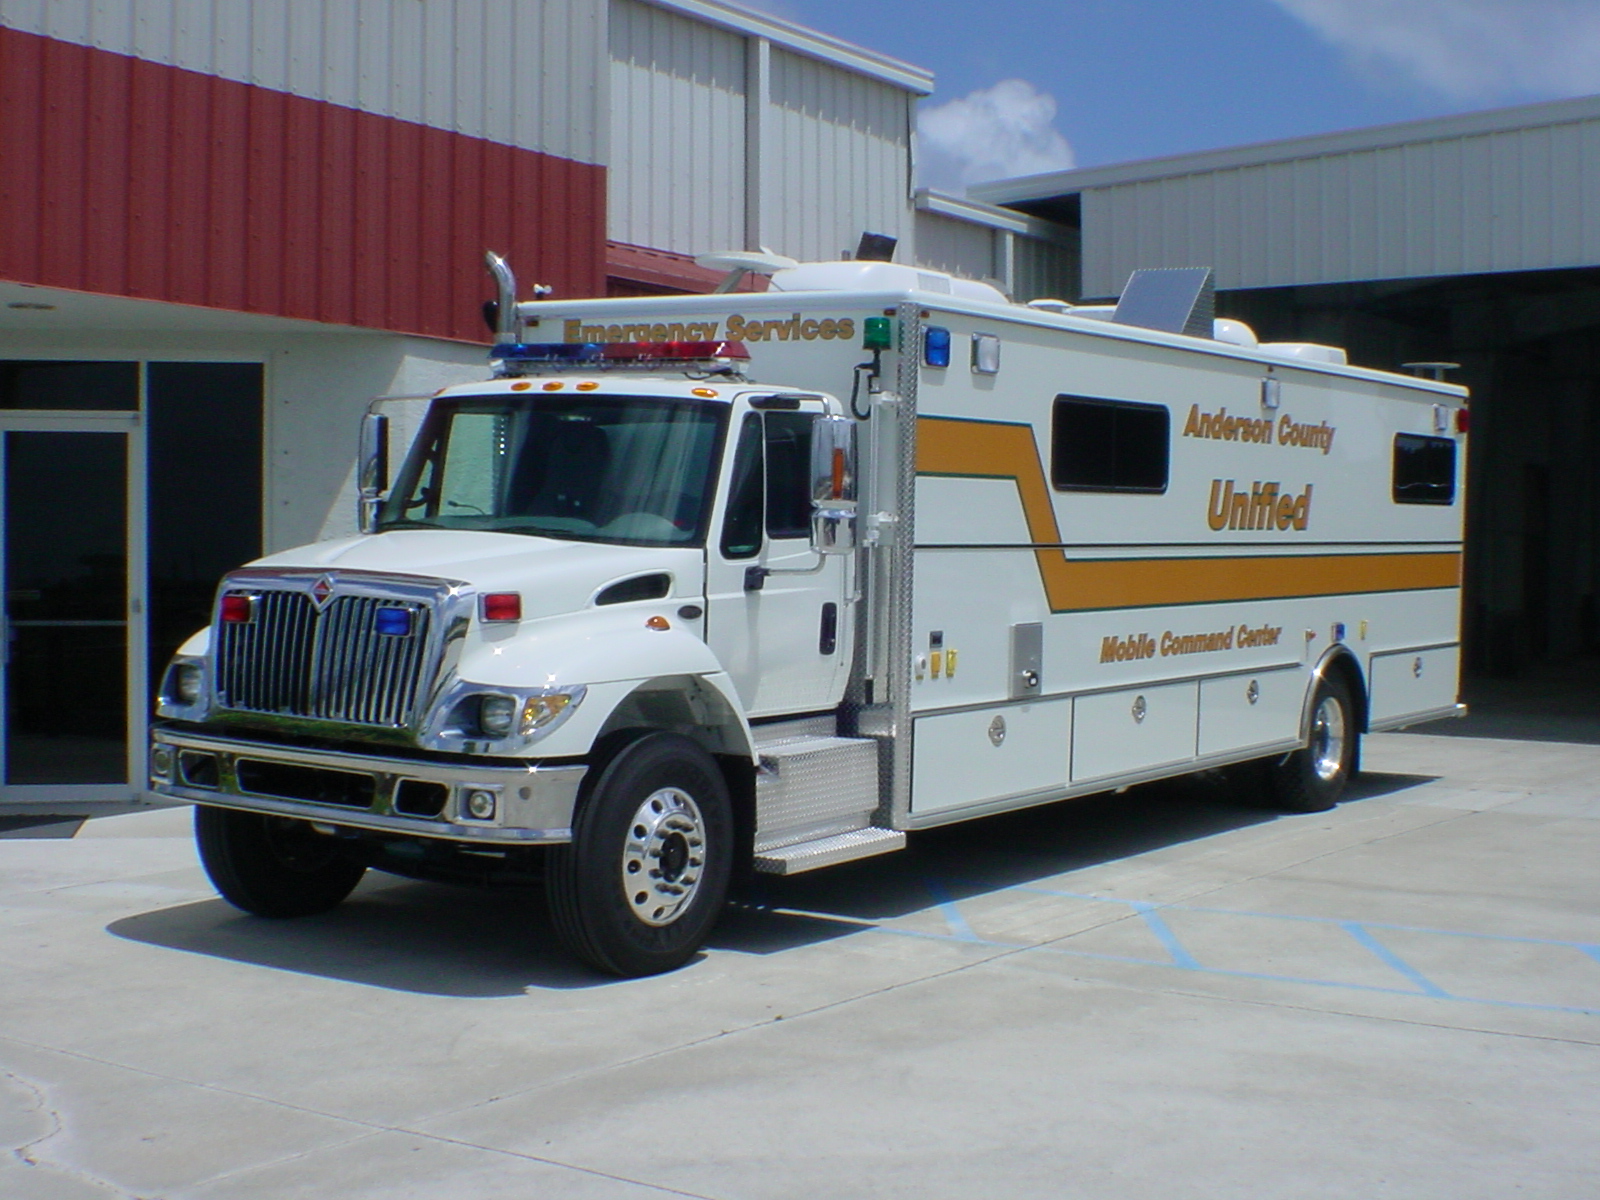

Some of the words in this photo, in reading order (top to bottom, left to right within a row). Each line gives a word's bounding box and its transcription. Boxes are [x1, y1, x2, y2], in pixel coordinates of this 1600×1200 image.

[563, 318, 718, 343] Emergency
[725, 313, 855, 342] Services
[1183, 403, 1274, 444] Anderson
[1277, 413, 1336, 455] County
[1208, 479, 1313, 531] Unified
[1100, 633, 1156, 664] Mobile
[1160, 625, 1235, 657] Command
[1237, 623, 1282, 649] Center
